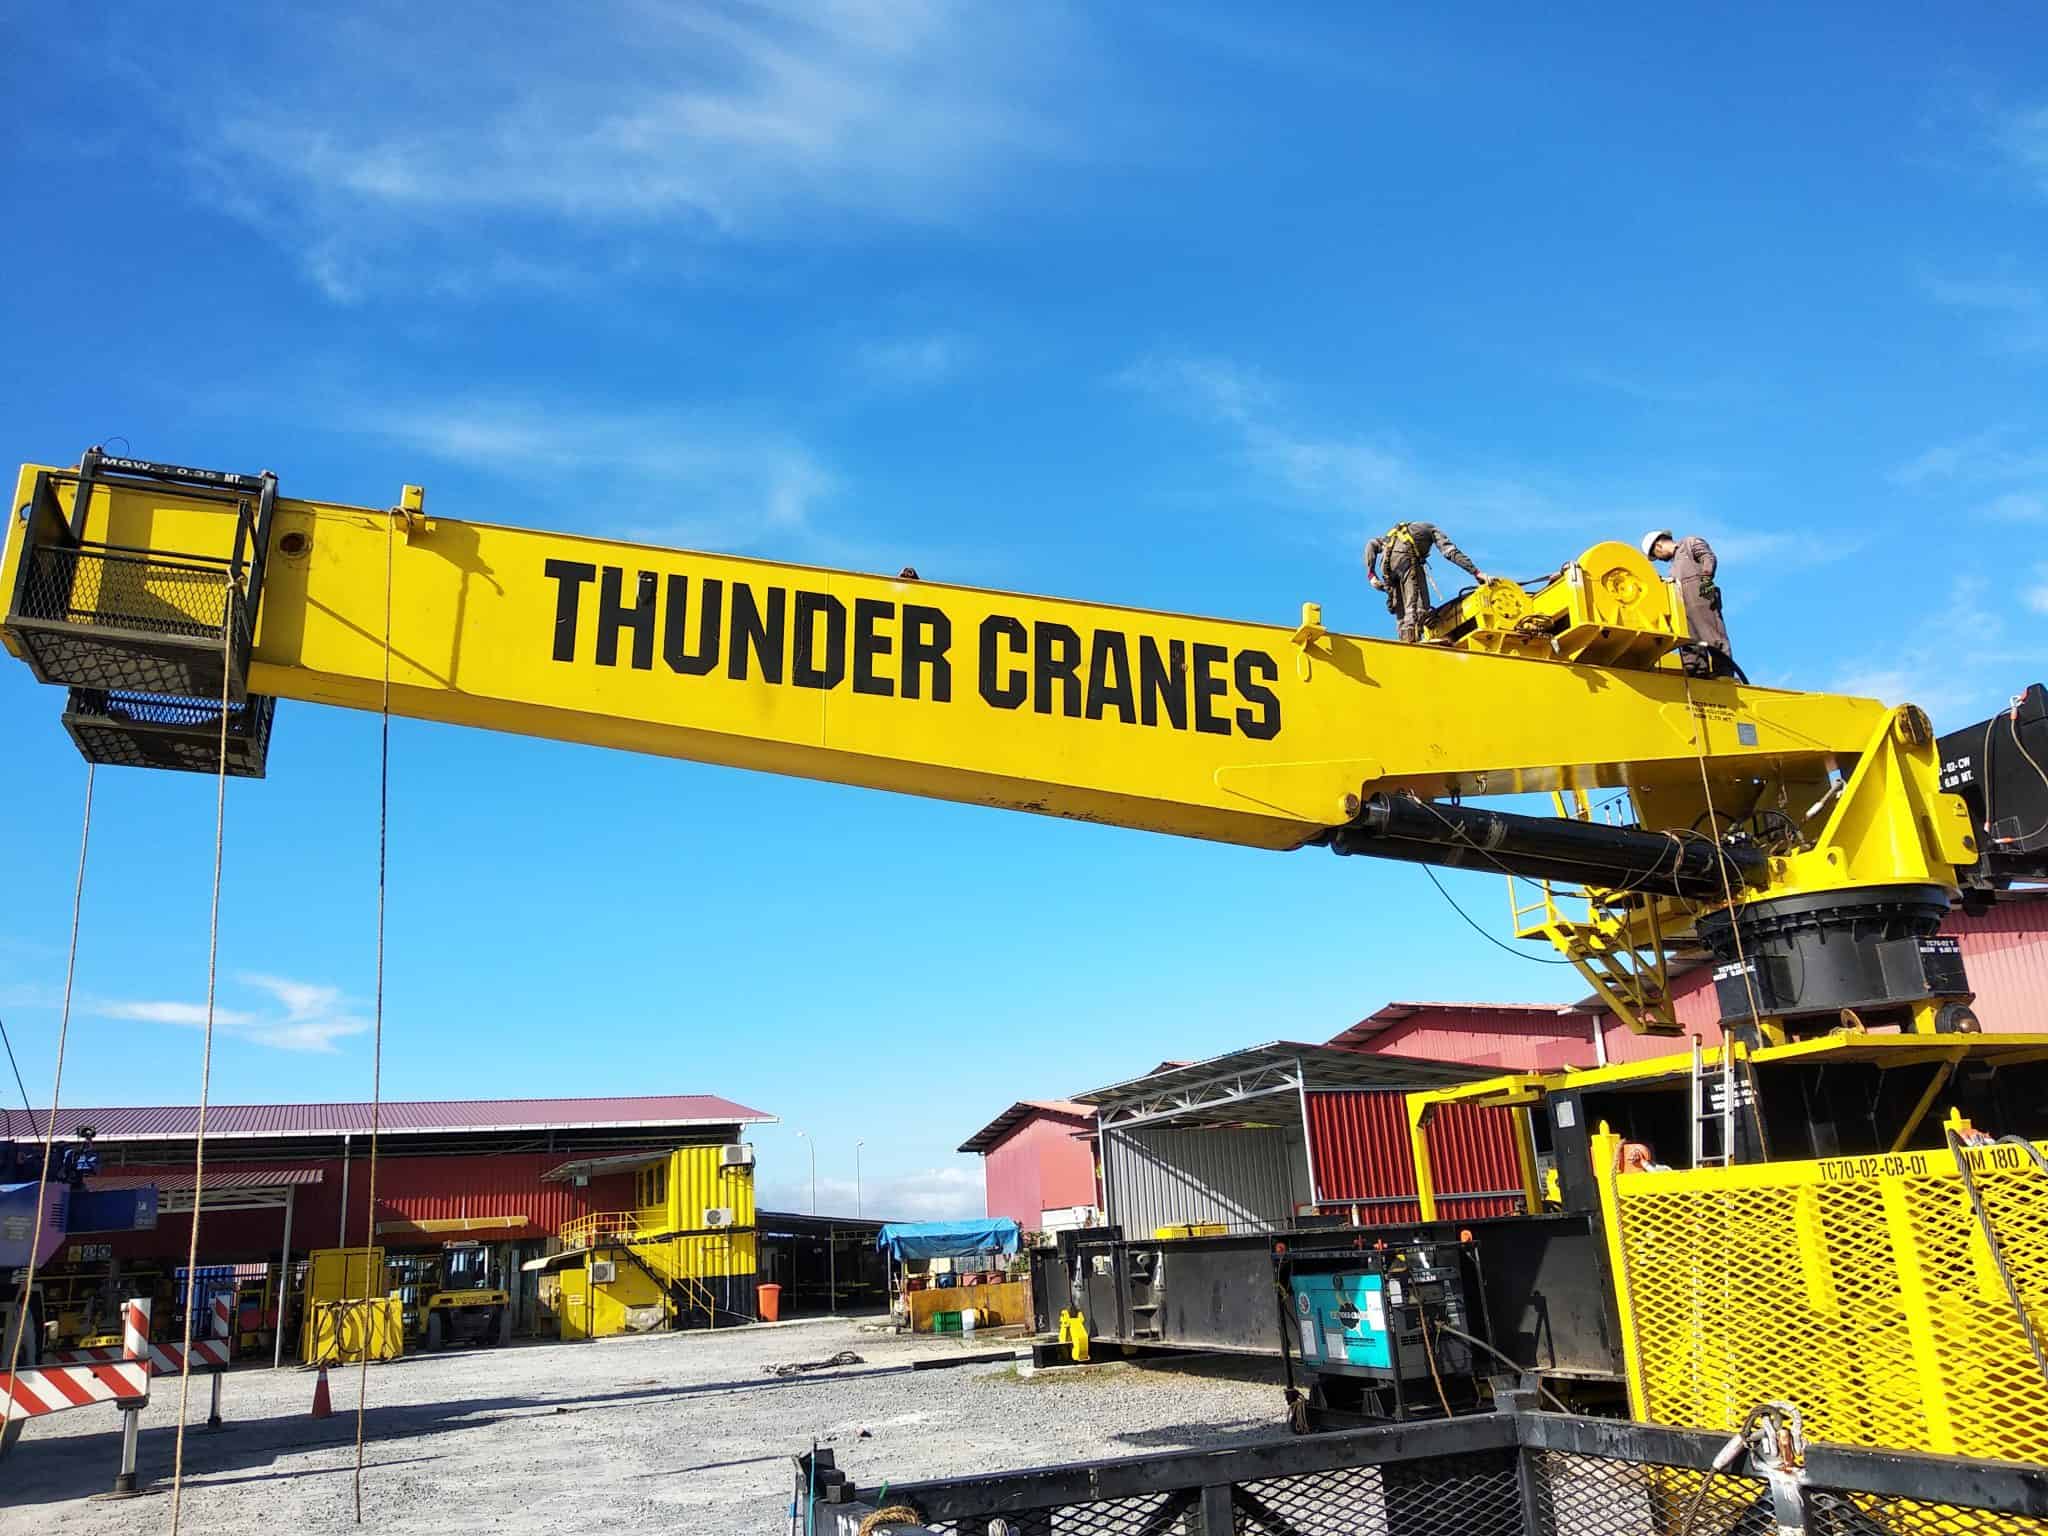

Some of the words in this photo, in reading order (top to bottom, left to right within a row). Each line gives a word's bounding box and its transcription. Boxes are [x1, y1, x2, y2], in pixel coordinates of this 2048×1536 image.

[544, 558, 951, 703] THUNDER
[977, 613, 1283, 741] CRANES
[1818, 1155, 1928, 1180] TC70-02-CB-01
[1989, 1147, 2020, 1169] 180
